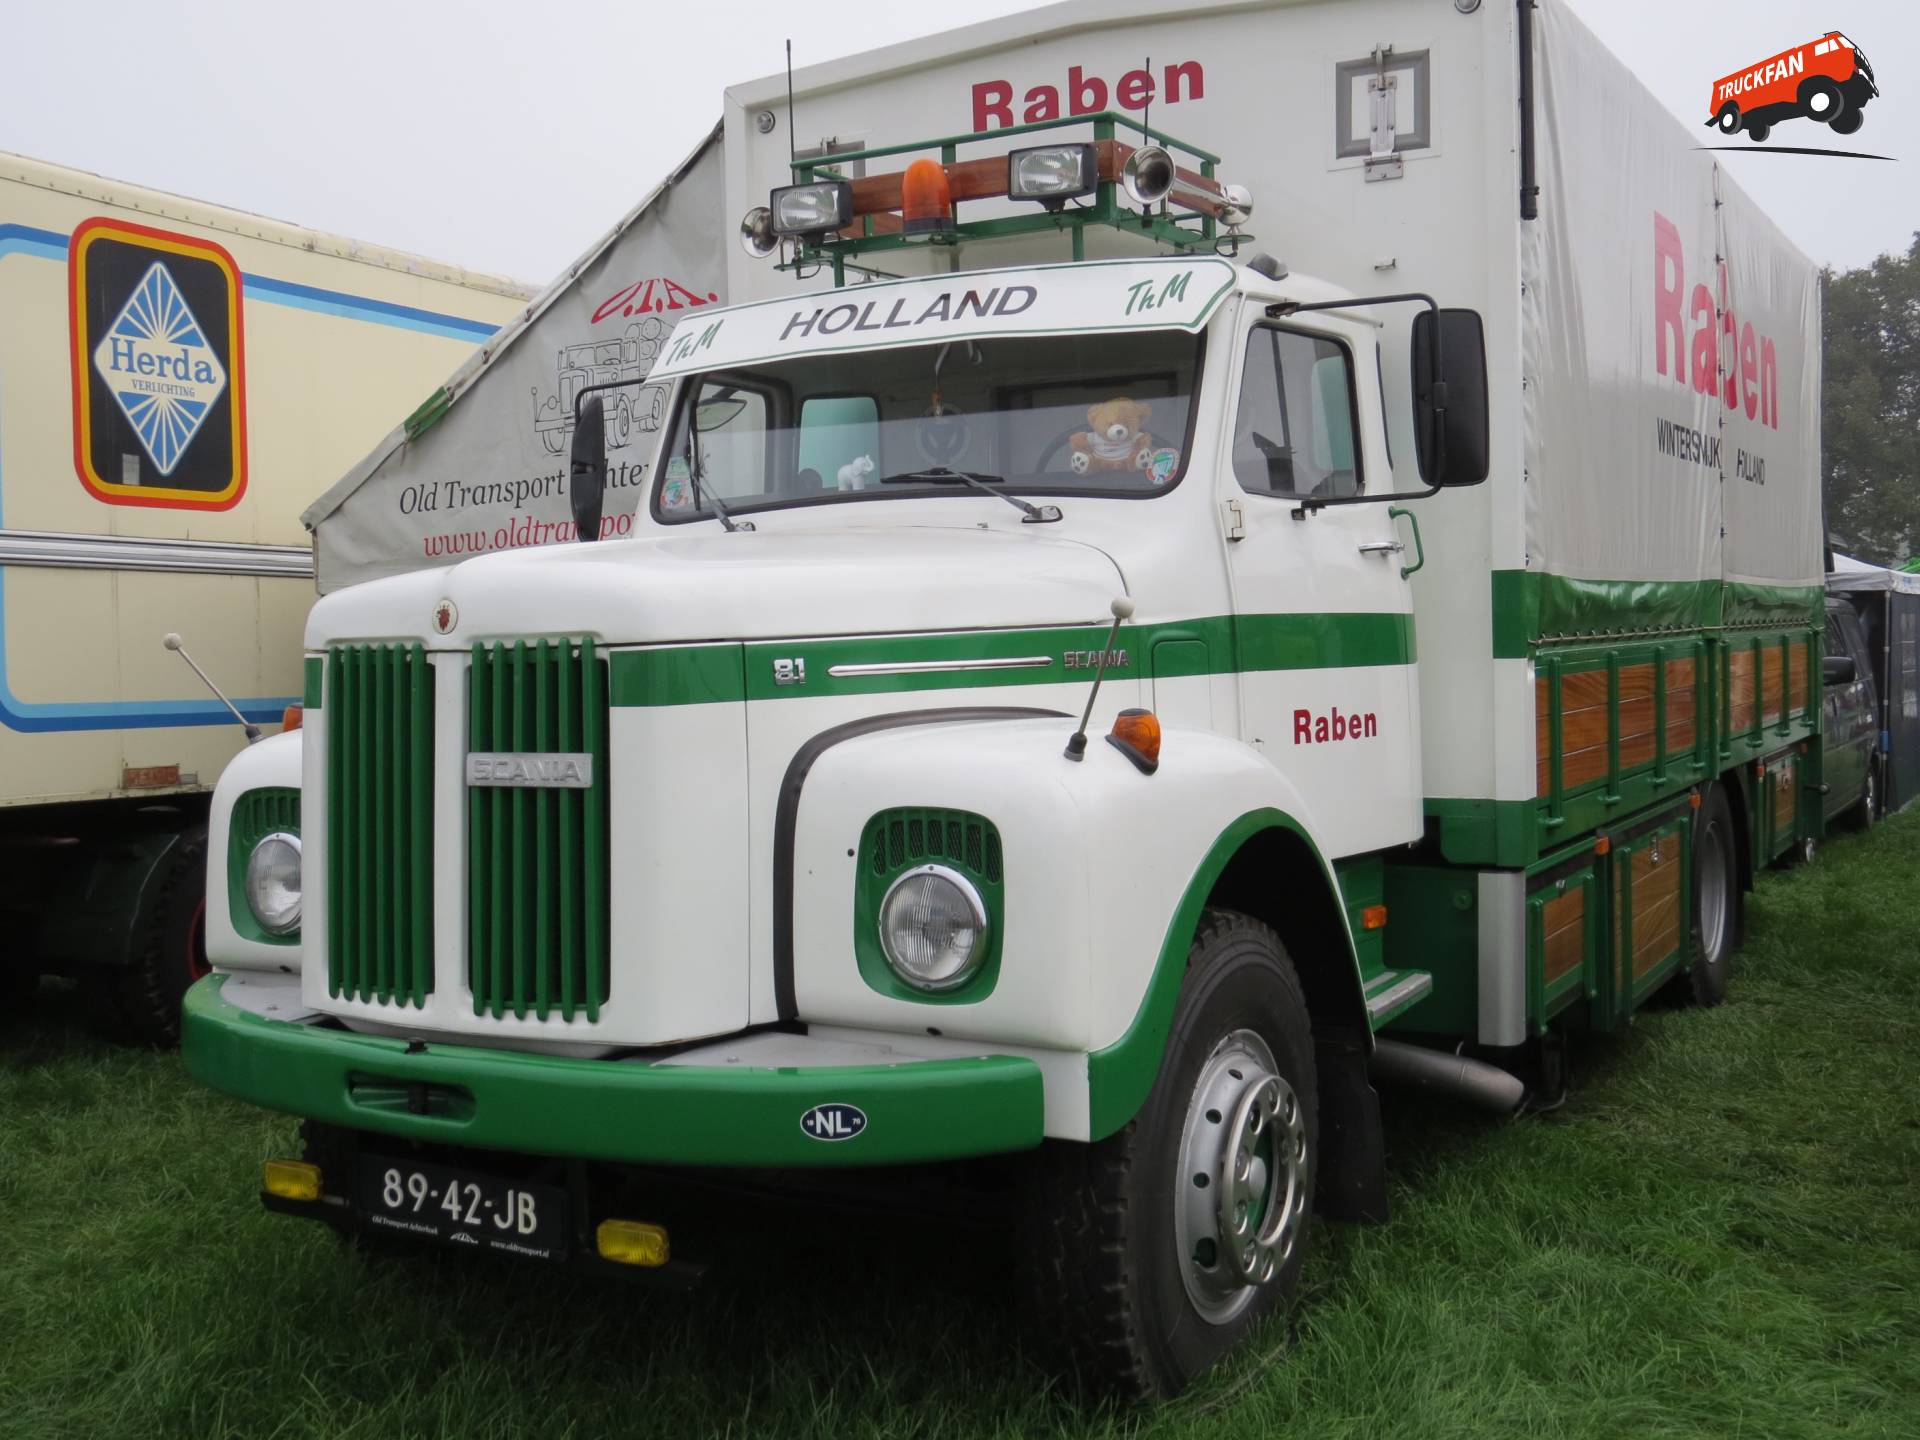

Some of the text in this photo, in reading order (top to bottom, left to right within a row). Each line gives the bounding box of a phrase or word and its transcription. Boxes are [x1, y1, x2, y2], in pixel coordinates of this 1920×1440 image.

[972, 60, 1204, 133] Raben
[779, 285, 1038, 341] HOLLAND
[1654, 210, 1778, 431] Raben
[109, 336, 216, 384] Herda
[131, 379, 195, 398] VERLICHTING
[400, 482, 438, 515] Old
[445, 469, 566, 509] Transport
[774, 657, 805, 685] 81
[1293, 706, 1377, 745] Raben
[474, 759, 581, 782] SCANIA
[815, 1110, 852, 1137] NL
[383, 1168, 538, 1235] 89-42-JB
